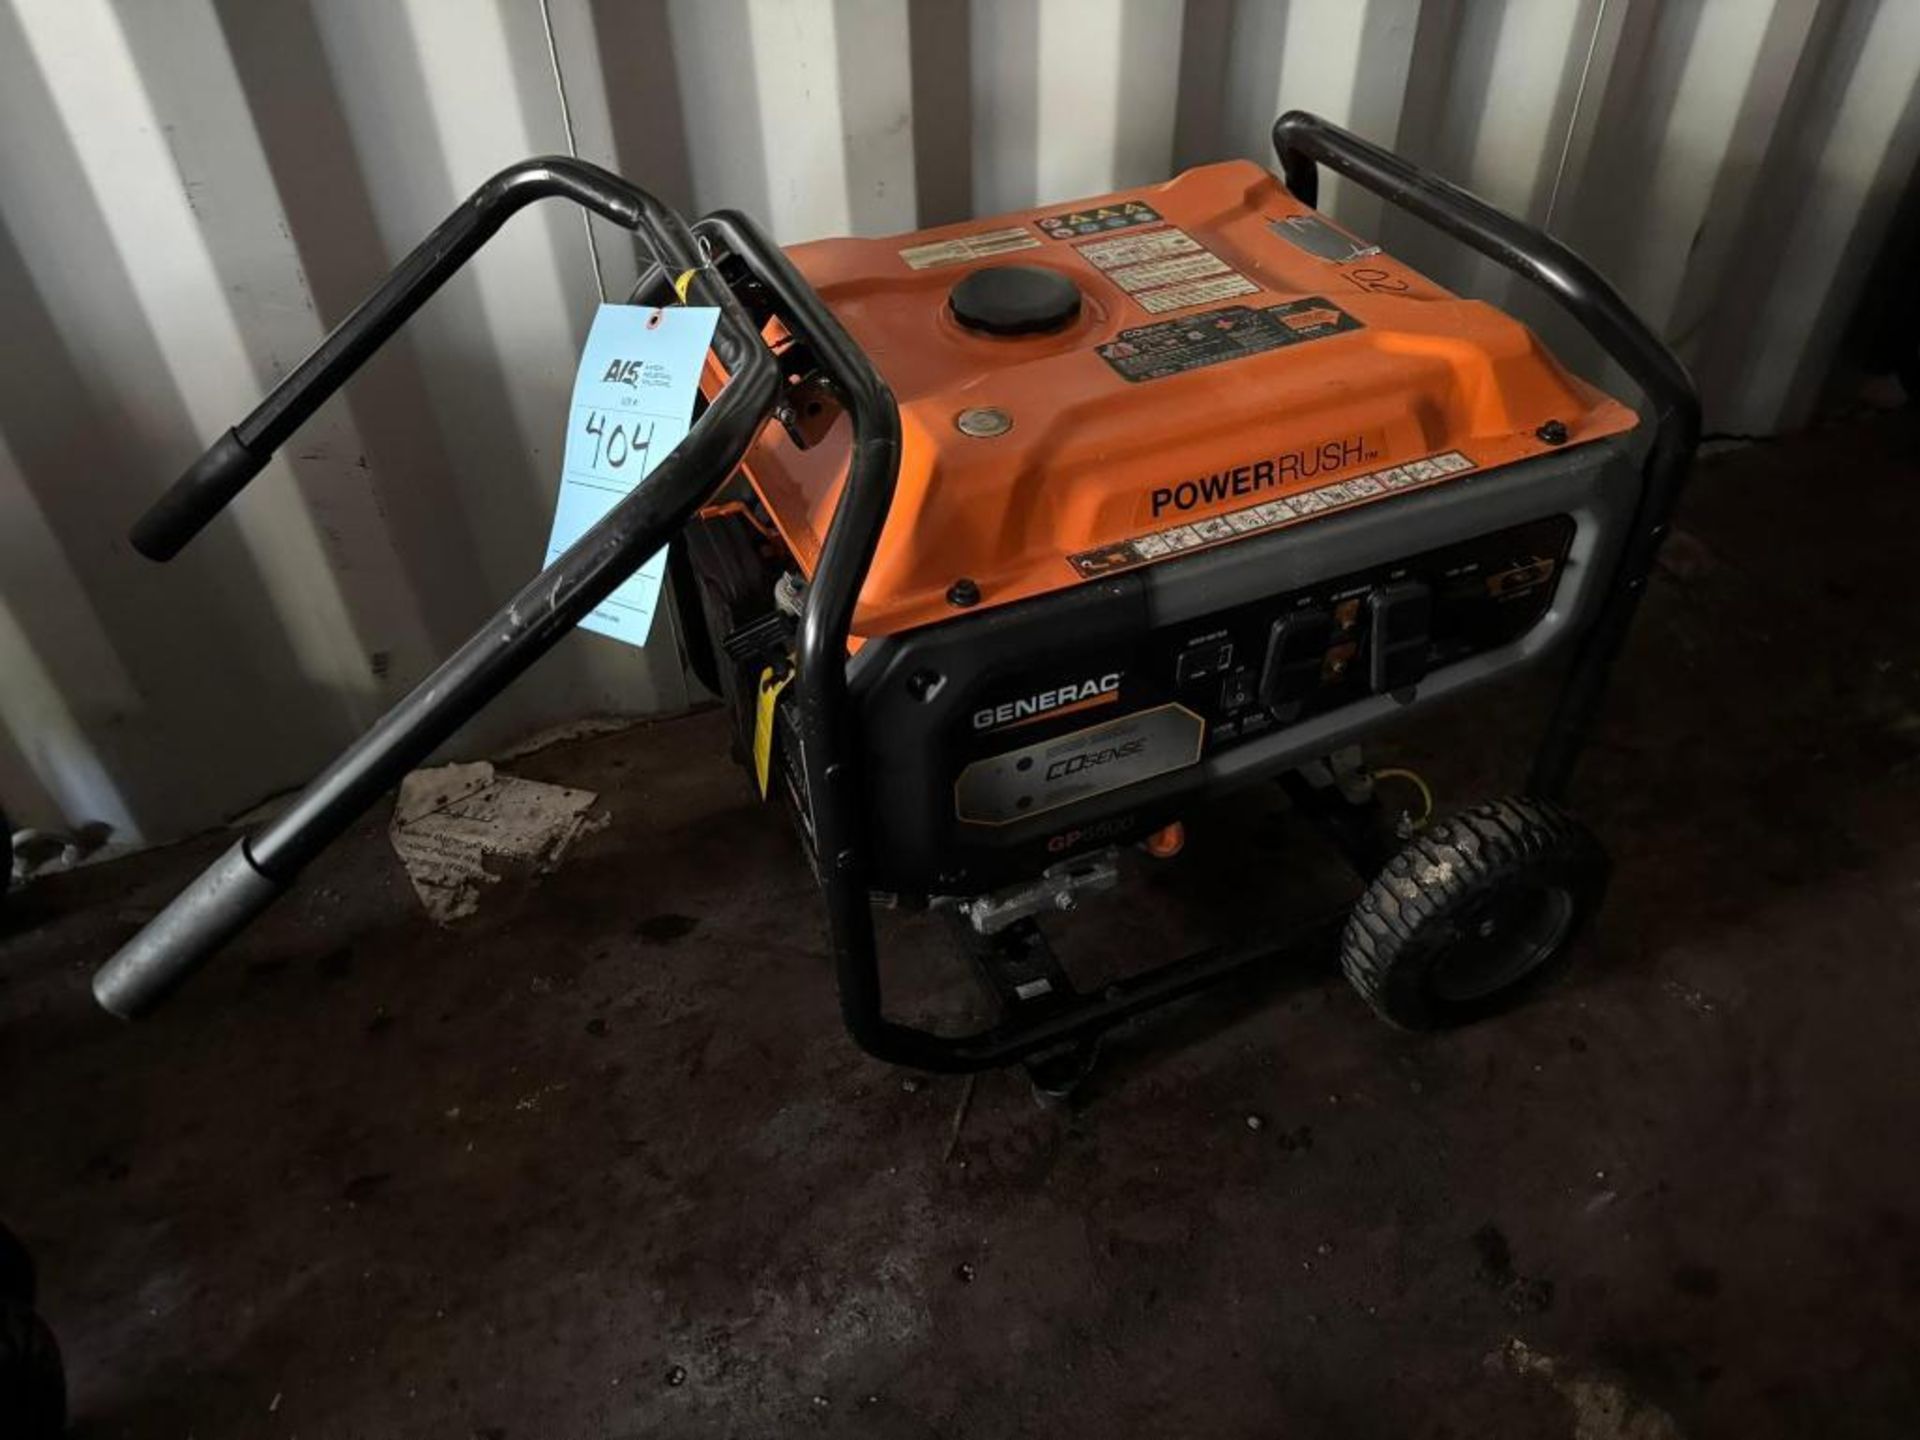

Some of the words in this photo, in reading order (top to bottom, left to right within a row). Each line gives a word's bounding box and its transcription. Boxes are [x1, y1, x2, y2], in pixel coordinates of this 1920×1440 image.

[603, 359, 643, 389] AIS
[586, 410, 654, 480] 404
[973, 673, 1120, 729] GENERAC
